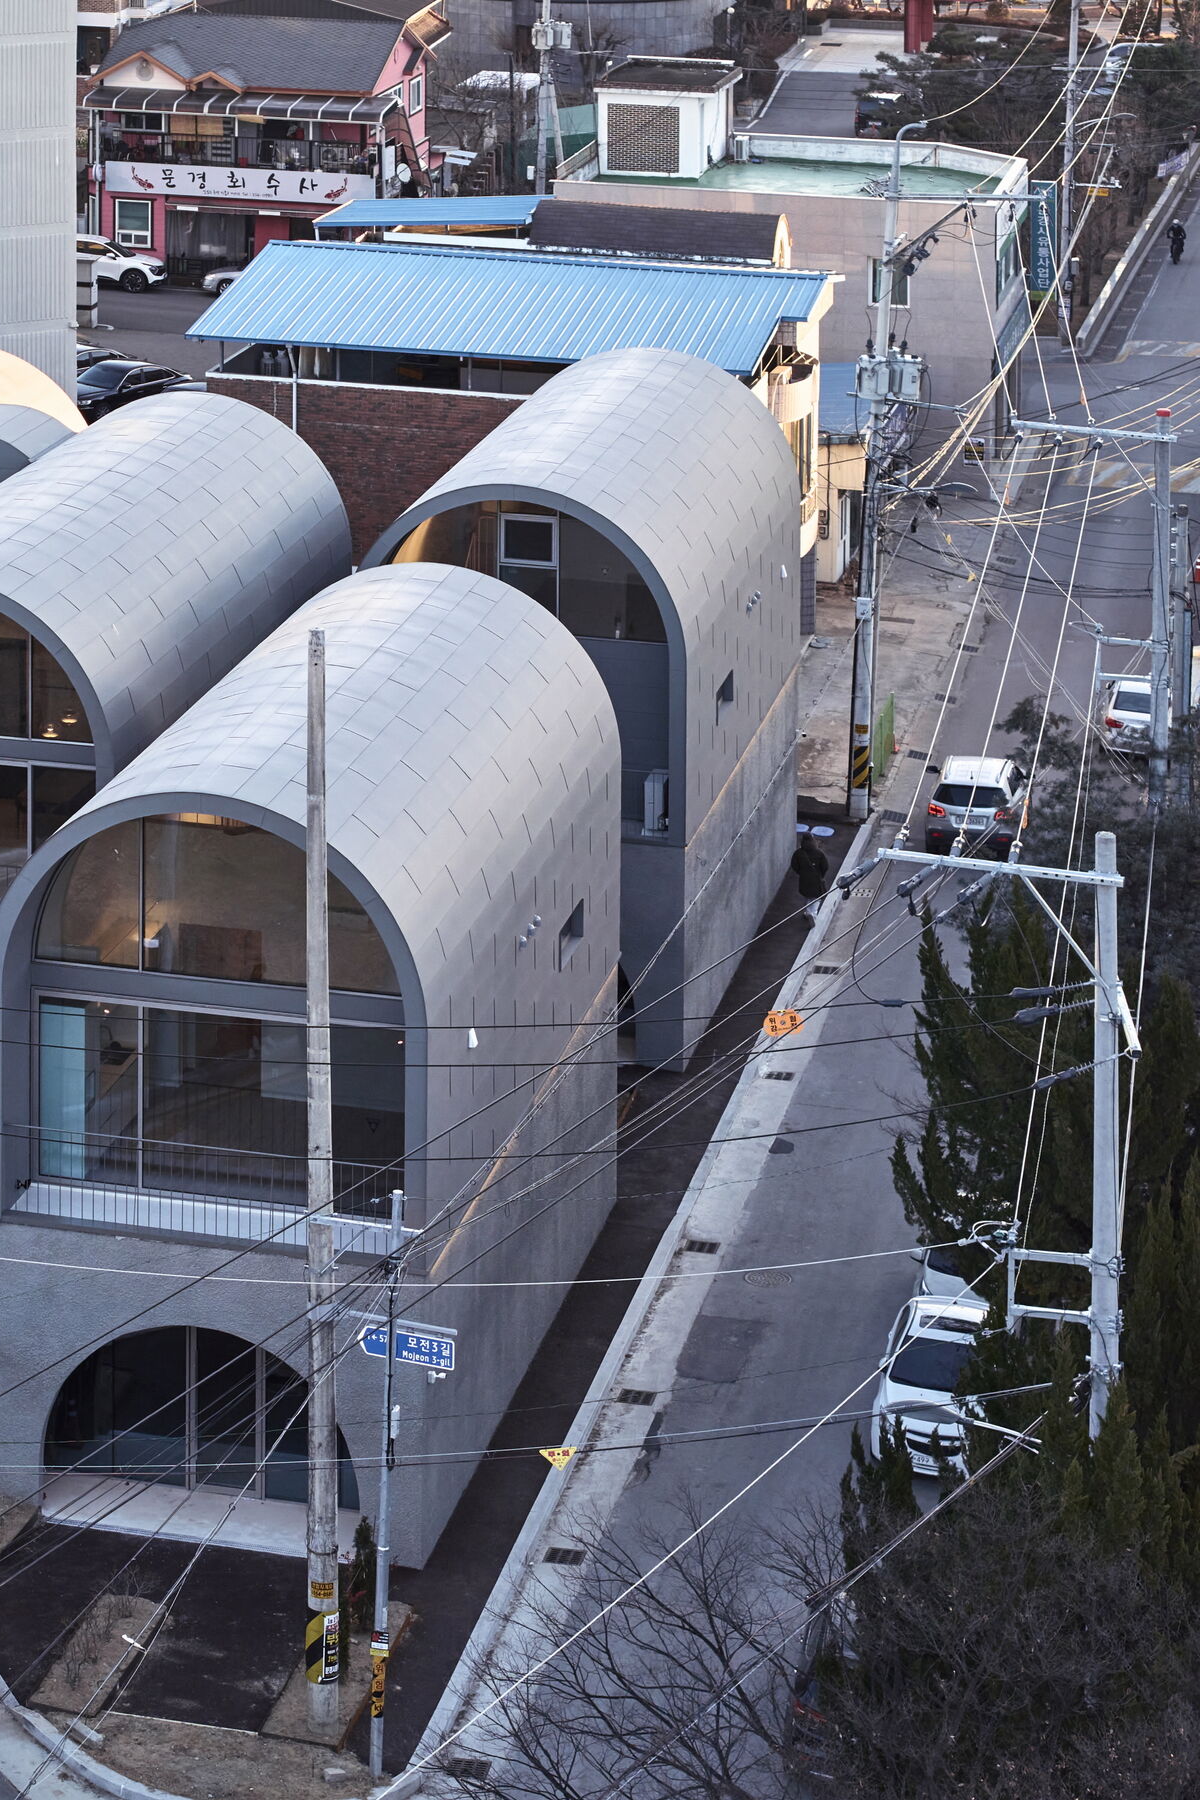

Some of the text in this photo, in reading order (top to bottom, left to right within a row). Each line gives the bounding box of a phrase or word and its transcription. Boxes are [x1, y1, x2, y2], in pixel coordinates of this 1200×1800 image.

[1037, 203, 1051, 289] 경시유통사업단
[407, 1336, 450, 1357] 모전3길
[402, 1350, 451, 1367] Mojeon 3-gil
